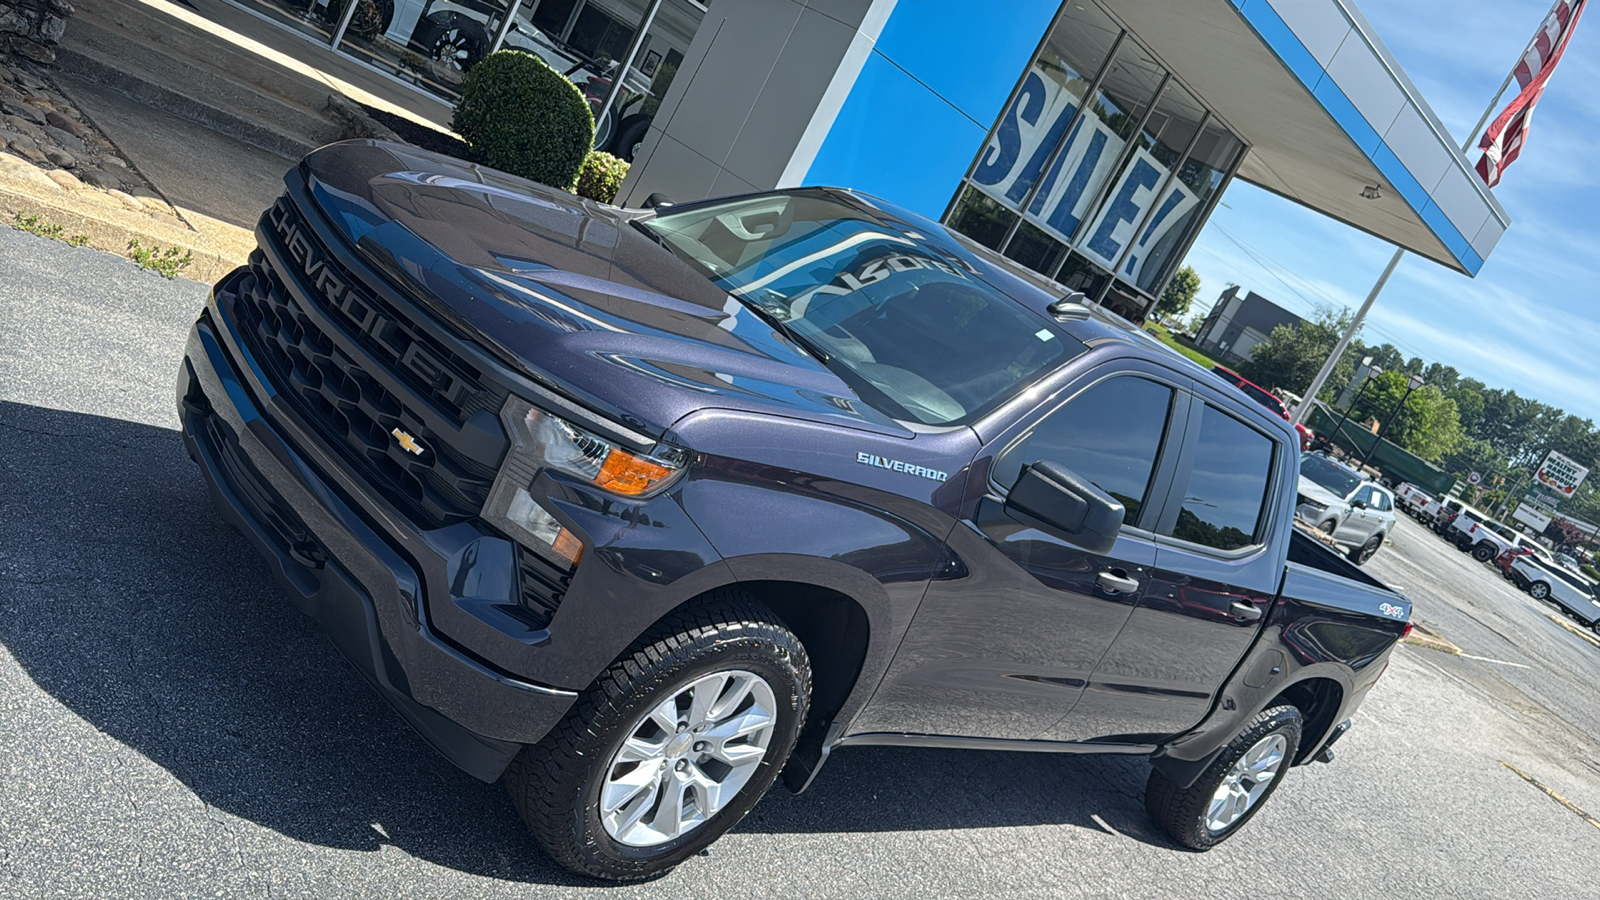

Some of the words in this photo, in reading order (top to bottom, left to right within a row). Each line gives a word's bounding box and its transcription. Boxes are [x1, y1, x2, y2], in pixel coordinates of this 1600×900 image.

[971, 71, 1186, 277] SALE!
[269, 199, 481, 400] CHEVROLET
[856, 452, 948, 482] SILVERADO
[1546, 456, 1577, 475] HEALTHY
[1546, 463, 1578, 482] HARVEST
[1545, 470, 1578, 489] PRODUCE
